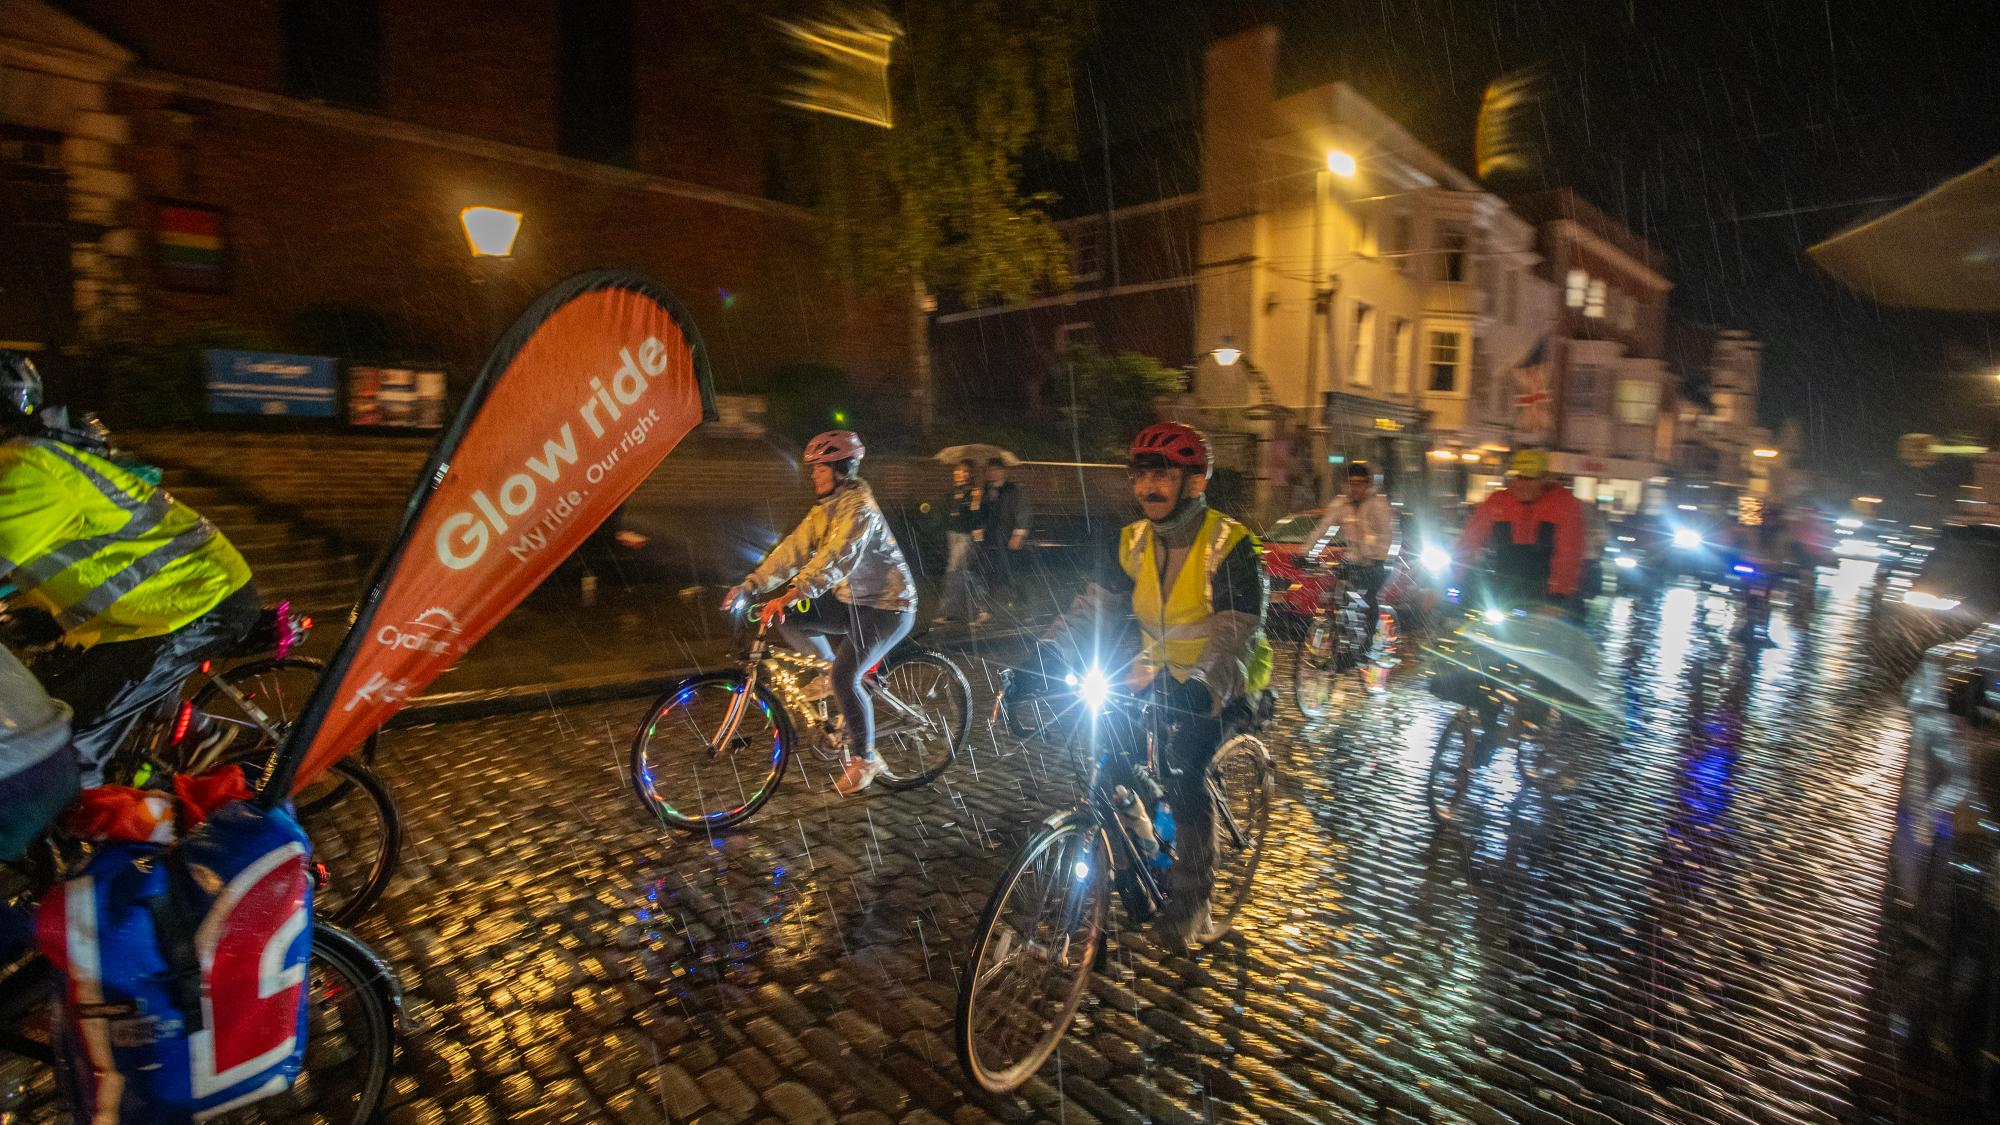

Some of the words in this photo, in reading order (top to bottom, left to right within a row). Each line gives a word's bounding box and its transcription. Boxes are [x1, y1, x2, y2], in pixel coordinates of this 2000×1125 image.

[435, 422, 579, 569] Glow
[579, 336, 668, 439] ride
[507, 528, 547, 563] My
[586, 448, 620, 484] Our
[620, 409, 660, 453] right
